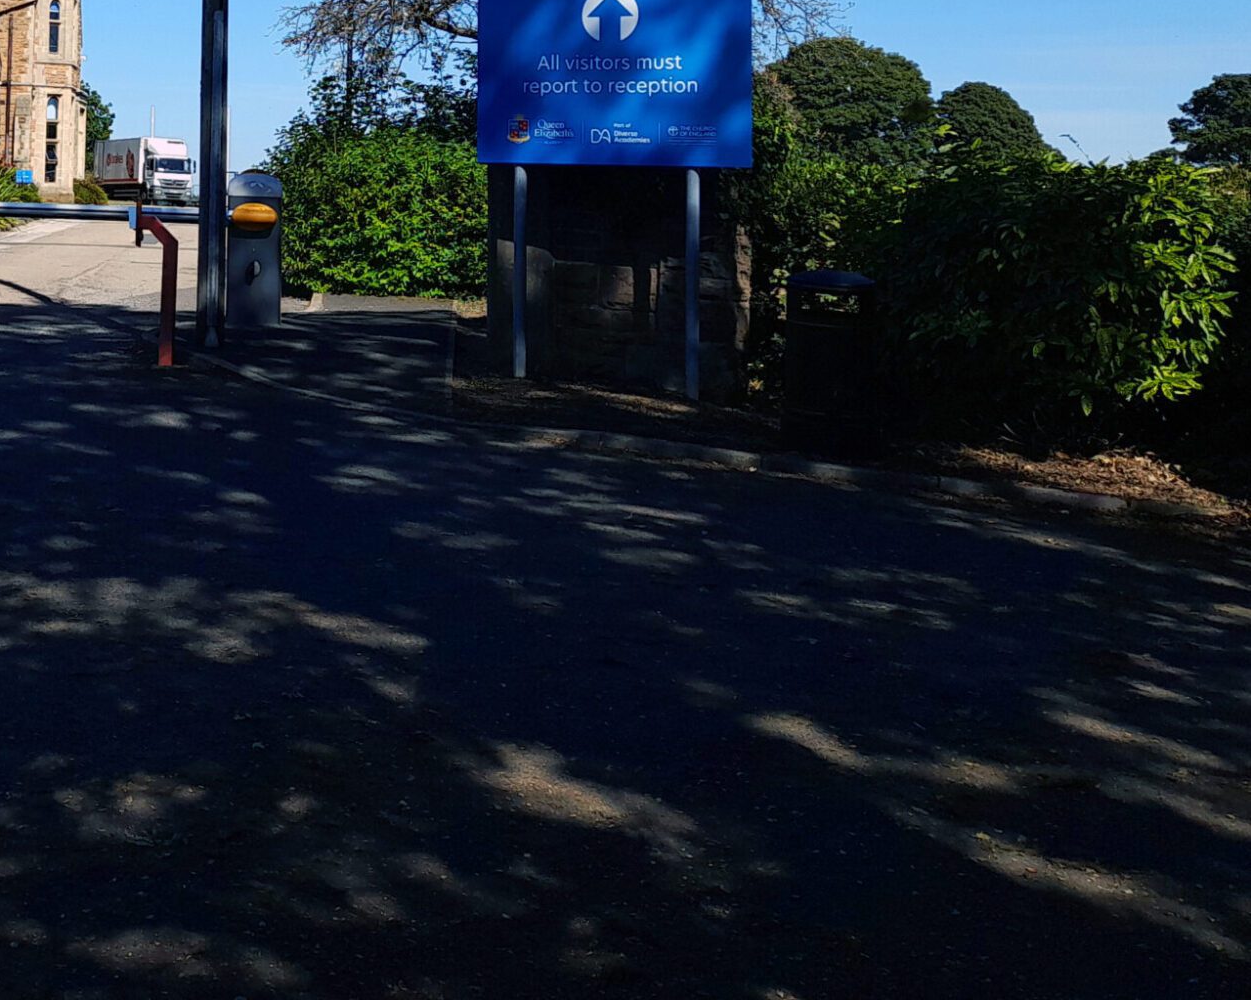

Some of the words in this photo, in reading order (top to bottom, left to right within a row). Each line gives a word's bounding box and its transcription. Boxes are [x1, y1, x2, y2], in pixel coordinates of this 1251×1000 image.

[537, 54, 560, 71] All
[565, 54, 631, 71] visitors
[636, 55, 683, 70] must
[523, 80, 578, 97] report
[583, 80, 602, 94] to
[608, 77, 698, 97] reception
[537, 119, 565, 131] Queen
